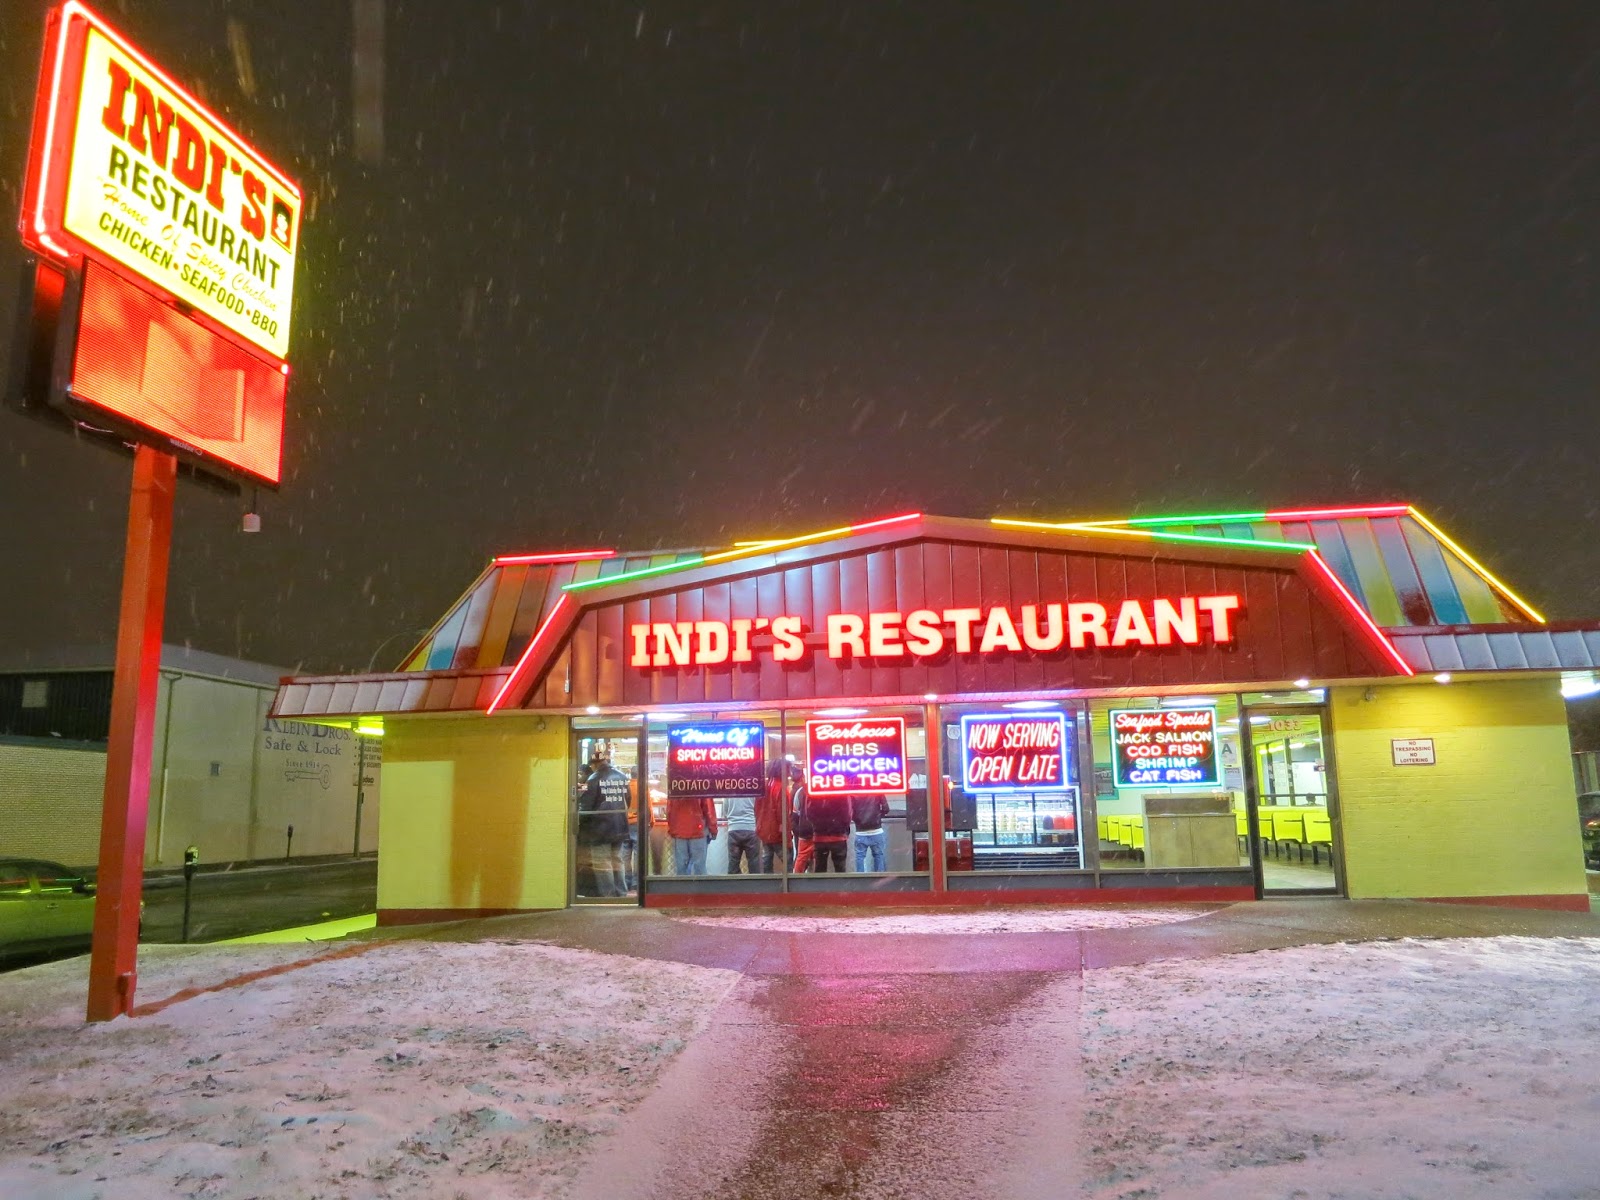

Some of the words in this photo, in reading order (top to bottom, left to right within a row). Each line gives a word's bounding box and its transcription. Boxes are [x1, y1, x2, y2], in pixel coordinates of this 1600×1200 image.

[101, 57, 267, 243] INDI'S
[108, 145, 281, 290] RESTAURANT
[99, 211, 173, 270] CHICKEN
[180, 264, 245, 316] SEAFOOD
[251, 309, 279, 339] BBQ
[631, 616, 805, 668] INDI'S
[827, 595, 1239, 660] RESTAURANT
[1115, 713, 1162, 732] Seafood
[1164, 711, 1210, 729] Special
[815, 723, 896, 740] Barbecue
[968, 723, 1001, 750] NOW
[1003, 721, 1060, 749] SERVING
[1116, 732, 1151, 745] JACK
[1155, 731, 1212, 743] SALMON
[265, 736, 292, 752] Safe
[297, 740, 308, 753] &
[315, 742, 341, 756] Lock
[831, 743, 879, 757] RIBS
[1126, 745, 1162, 757] COD
[1168, 743, 1203, 756] FISH
[1221, 743, 1233, 755] A
[677, 748, 708, 762] SPICY
[709, 747, 755, 760] CHICKEN
[813, 757, 899, 773] CHICKEN
[968, 756, 1014, 783] OPEN
[1017, 754, 1060, 781] LATE
[1135, 757, 1198, 769] SHRIMP
[811, 774, 845, 788] RIB
[1129, 770, 1160, 783] CAT
[1166, 769, 1202, 782] FISH
[671, 779, 710, 791] POTATO
[715, 778, 759, 790] WEDGES
